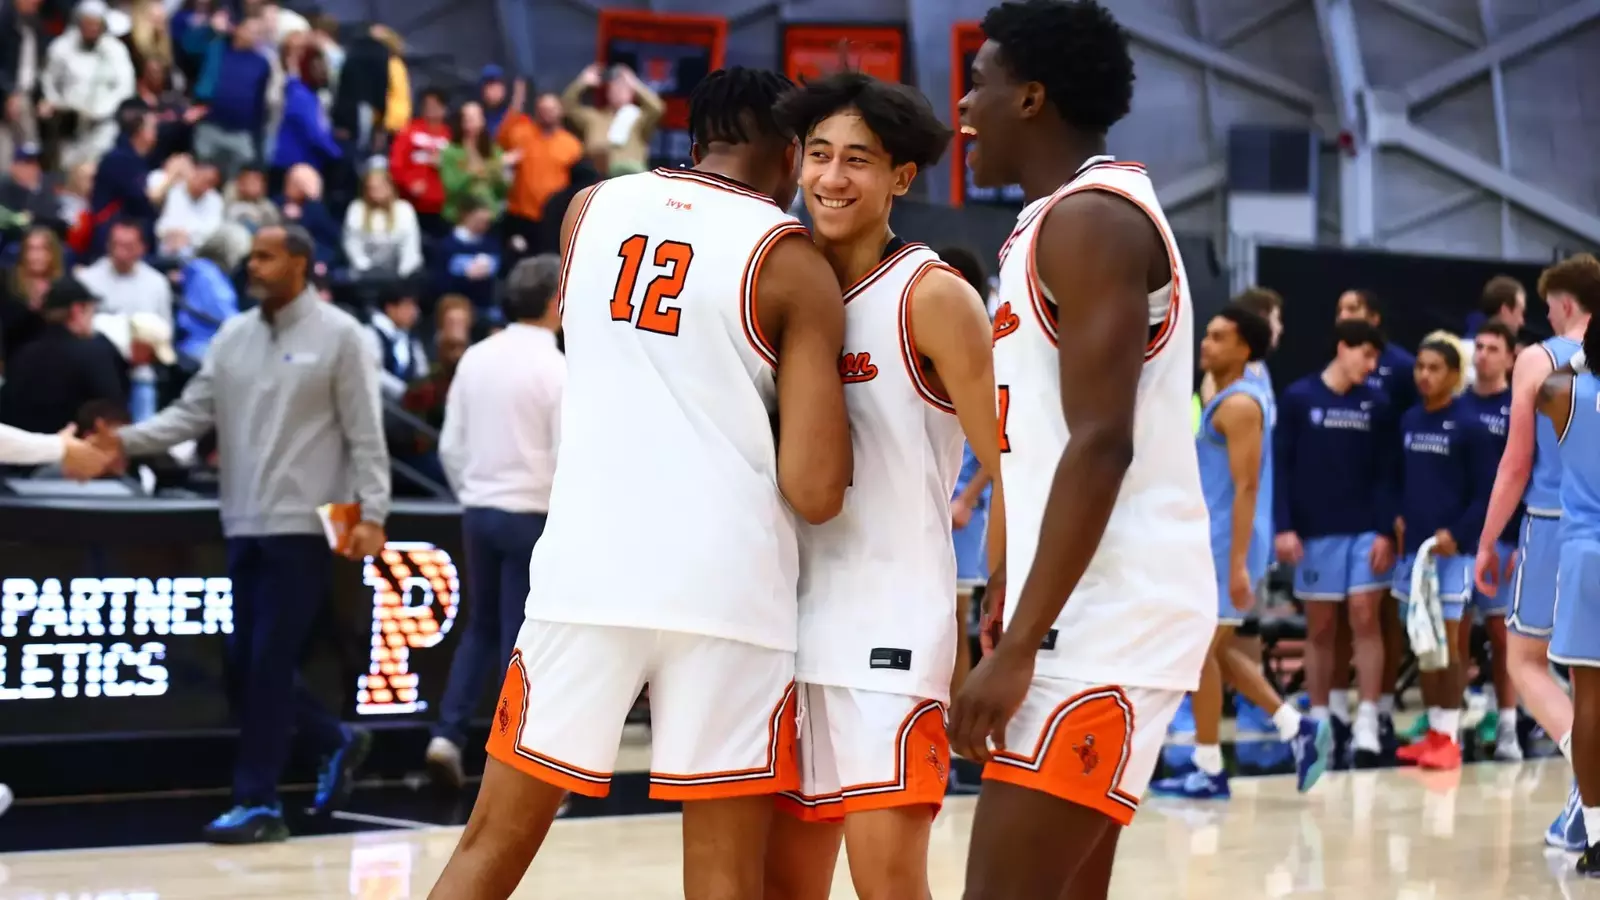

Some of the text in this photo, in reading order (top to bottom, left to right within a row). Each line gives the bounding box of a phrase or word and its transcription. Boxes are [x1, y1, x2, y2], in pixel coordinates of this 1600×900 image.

[665, 198, 684, 210] Ivy
[609, 234, 695, 337] 12
[1, 577, 234, 636] PARTNER
[357, 541, 459, 714] P
